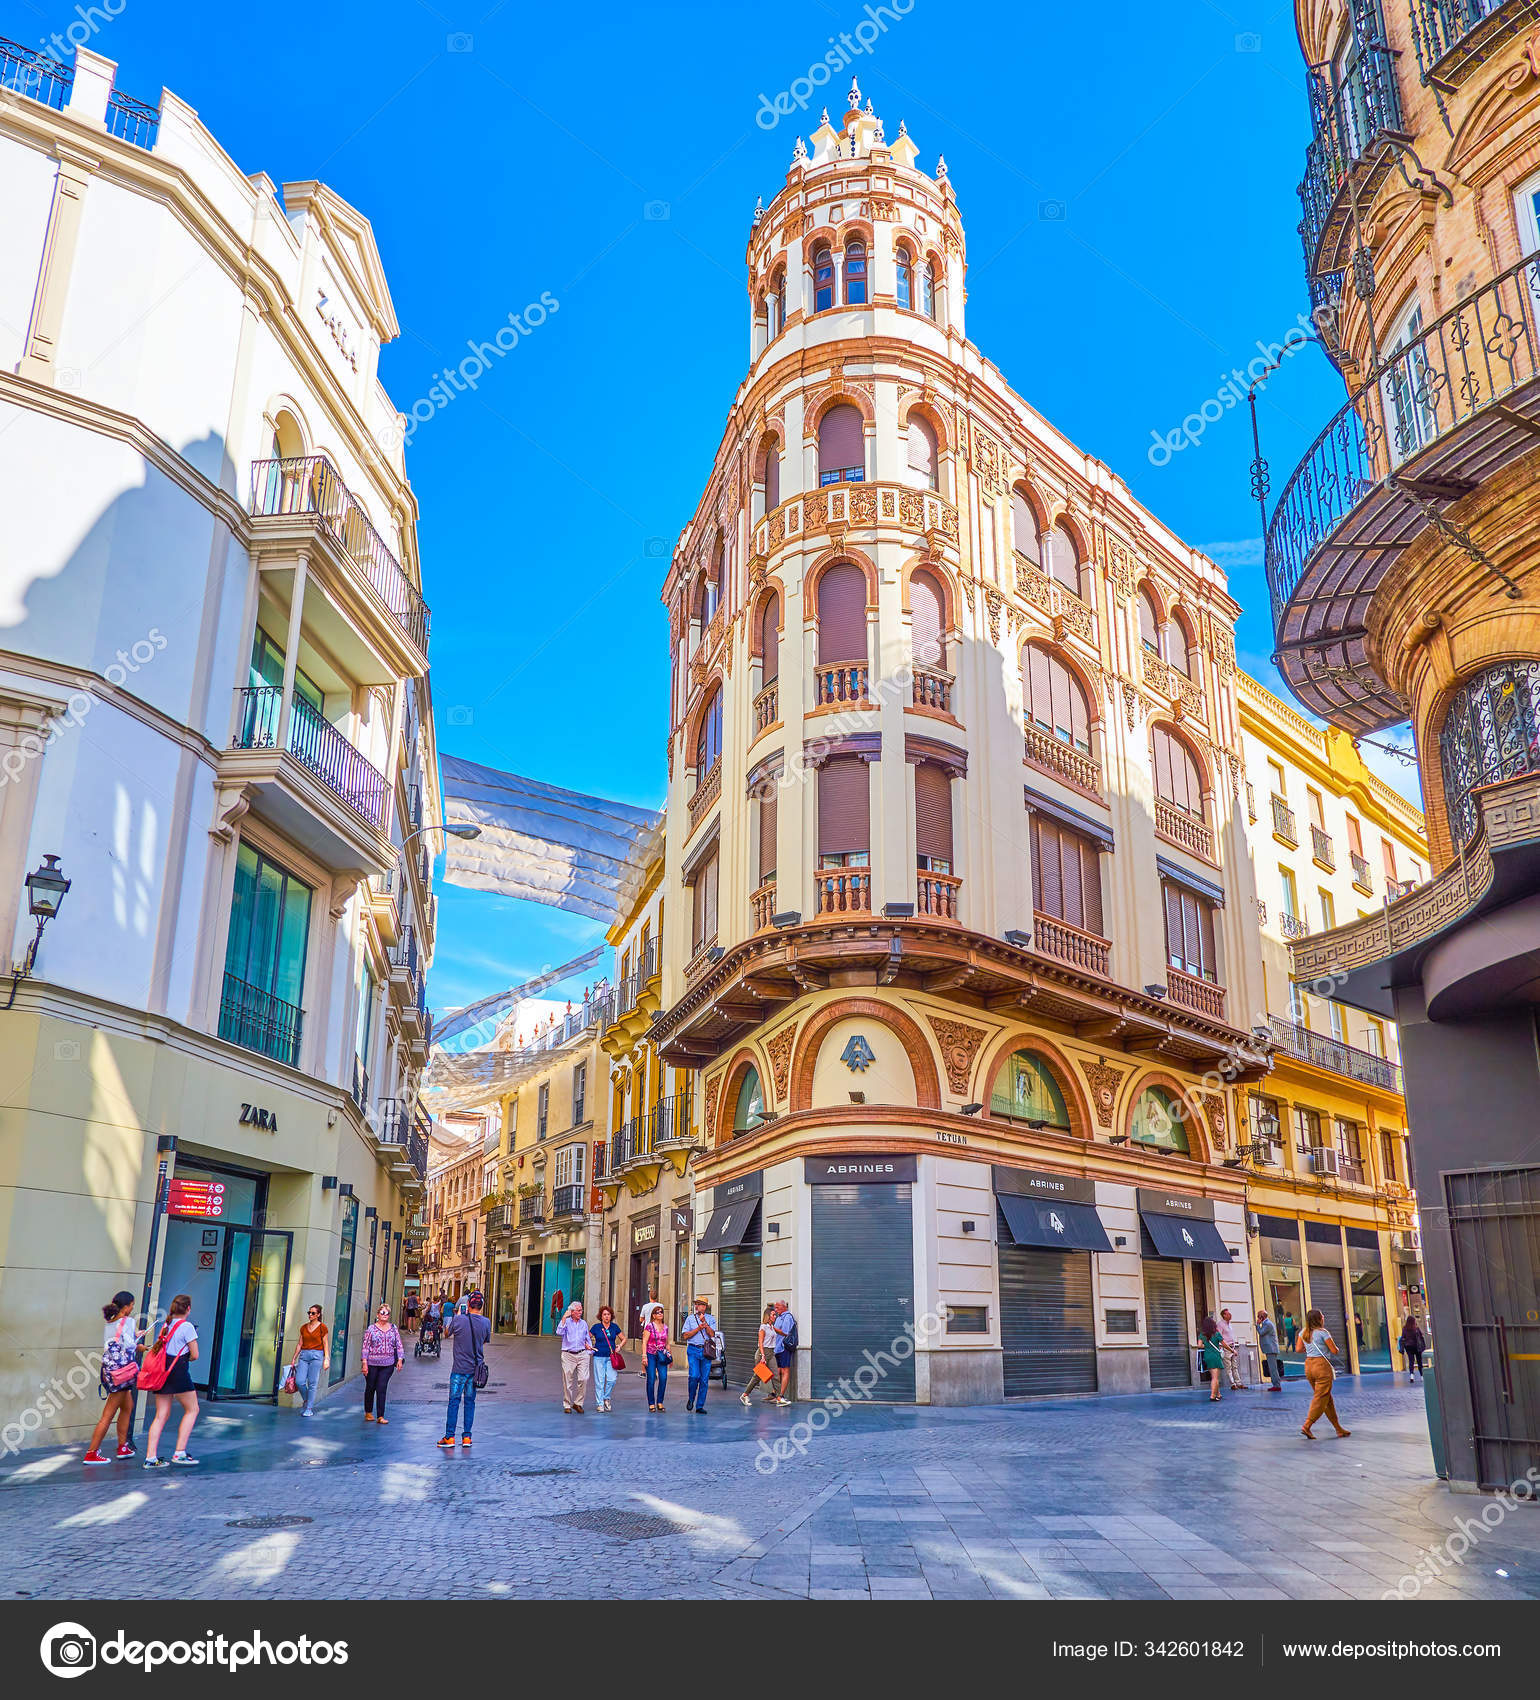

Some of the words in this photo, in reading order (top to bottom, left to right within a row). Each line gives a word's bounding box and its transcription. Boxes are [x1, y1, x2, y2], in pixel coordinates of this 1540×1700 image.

[238, 1102, 278, 1133] ZARA
[936, 1130, 968, 1145] TETUAN
[826, 1163, 895, 1174] ABRINES
[1029, 1178, 1065, 1192] ABRINES
[1165, 1199, 1192, 1211] ABRINES
